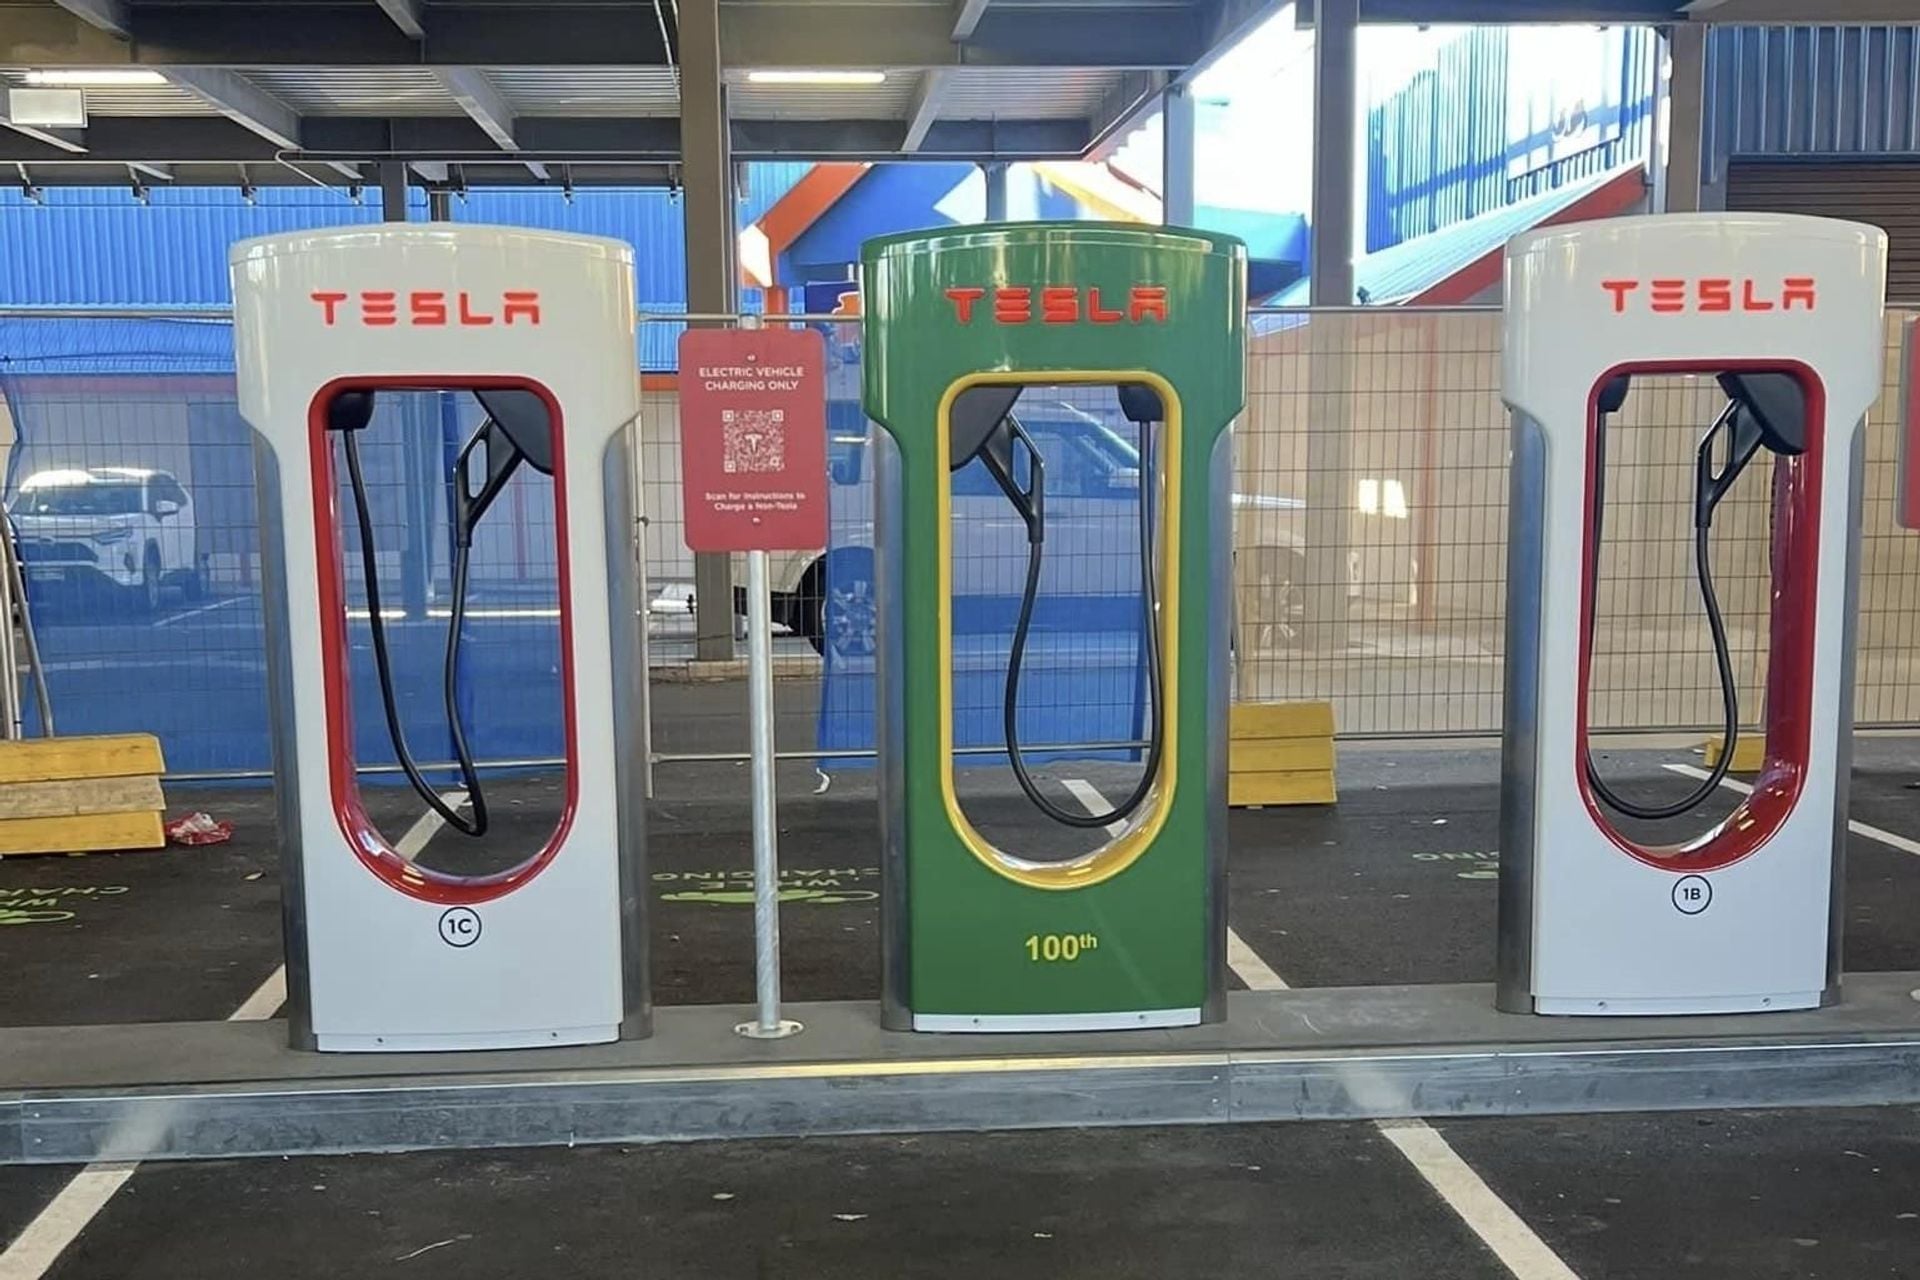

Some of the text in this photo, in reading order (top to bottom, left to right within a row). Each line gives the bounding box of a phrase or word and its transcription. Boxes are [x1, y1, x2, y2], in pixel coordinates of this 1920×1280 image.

[1601, 278, 1815, 313] TESLA
[310, 292, 540, 326] TESLA
[944, 286, 1168, 325] TESLA
[699, 366, 804, 378] ELECTRIC VEHICLE
[705, 379, 800, 391] CHARGING ONLY
[705, 491, 727, 501] Scan
[728, 491, 741, 500] for
[796, 491, 806, 500] to
[714, 502, 745, 512] Charge
[755, 501, 798, 511] Non-Tesla
[699, 879, 841, 890] WHLE
[1682, 887, 1702, 901] 1B
[448, 918, 472, 934] 1C
[1025, 932, 1098, 961] 100th
